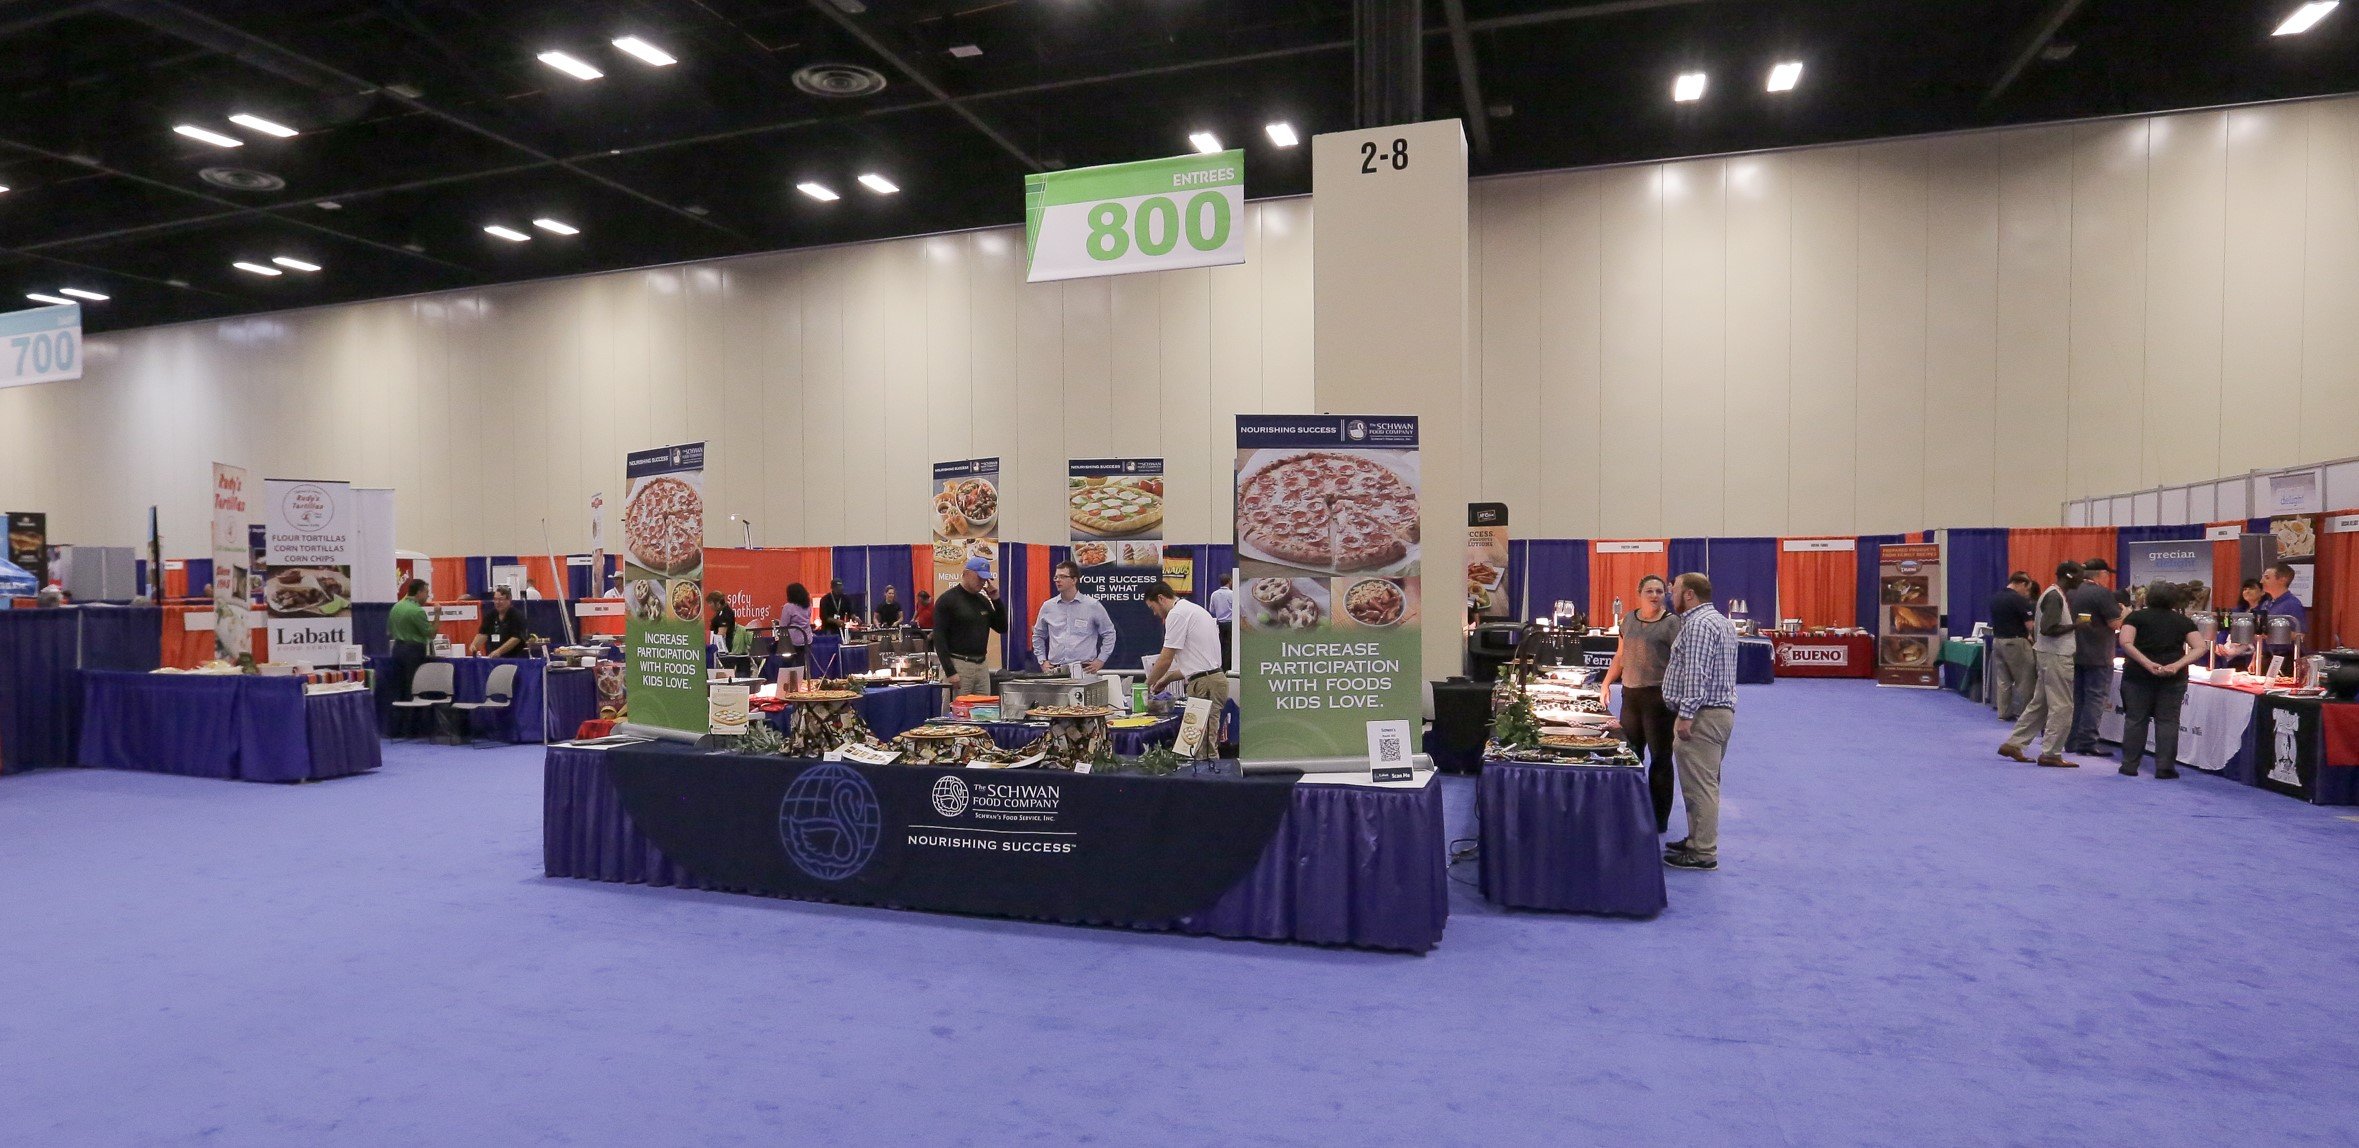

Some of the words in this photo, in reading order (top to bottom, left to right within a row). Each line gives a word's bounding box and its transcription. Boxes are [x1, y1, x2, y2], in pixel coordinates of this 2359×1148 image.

[1361, 138, 1409, 174] 2-8
[1172, 167, 1235, 187] ENTREES
[1086, 190, 1231, 262] 800
[11, 331, 74, 376] 700
[1240, 426, 1296, 434] NOURISHING
[1297, 426, 1337, 434] SUCCESS
[1376, 422, 1414, 430] SCHWAN
[628, 458, 652, 466] NOURISHING
[652, 455, 669, 464] SUCCESS
[301, 534, 346, 542] TORTILLAS
[2149, 550, 2196, 561] grecian
[938, 572, 959, 580] MENU
[1080, 575, 1106, 583] YOUR
[1109, 575, 1157, 583] SUCCESS
[1109, 584, 1138, 592] WHAT
[727, 589, 751, 607] spicy
[1084, 593, 1130, 601] NSPIRES
[276, 627, 345, 645] Labatt
[644, 631, 689, 646] INCREASE
[637, 646, 700, 661] PARTICIPATION
[1281, 642, 1380, 657] INCREASE
[1792, 650, 1842, 661] BUENO
[1260, 659, 1399, 675] PARTICIPATION
[1583, 654, 1613, 666] Fern
[640, 661, 662, 673] WITH
[664, 662, 696, 675] FOODS
[642, 674, 663, 687] KIDS
[665, 676, 692, 690] LOVE.
[1268, 678, 1317, 692] WITH
[1326, 677, 1392, 691] FOODS
[1276, 696, 1321, 710] KIDS
[1328, 694, 1384, 709] LOVE.
[973, 784, 987, 792] The
[988, 784, 1060, 799] SCHWAN
[972, 796, 1000, 807] FOOD
[1004, 798, 1060, 809] COMPANY
[975, 812, 1002, 820] SCHWAN'S
[1019, 814, 1042, 822] SERVICE,
[907, 835, 998, 850] NOURISHING
